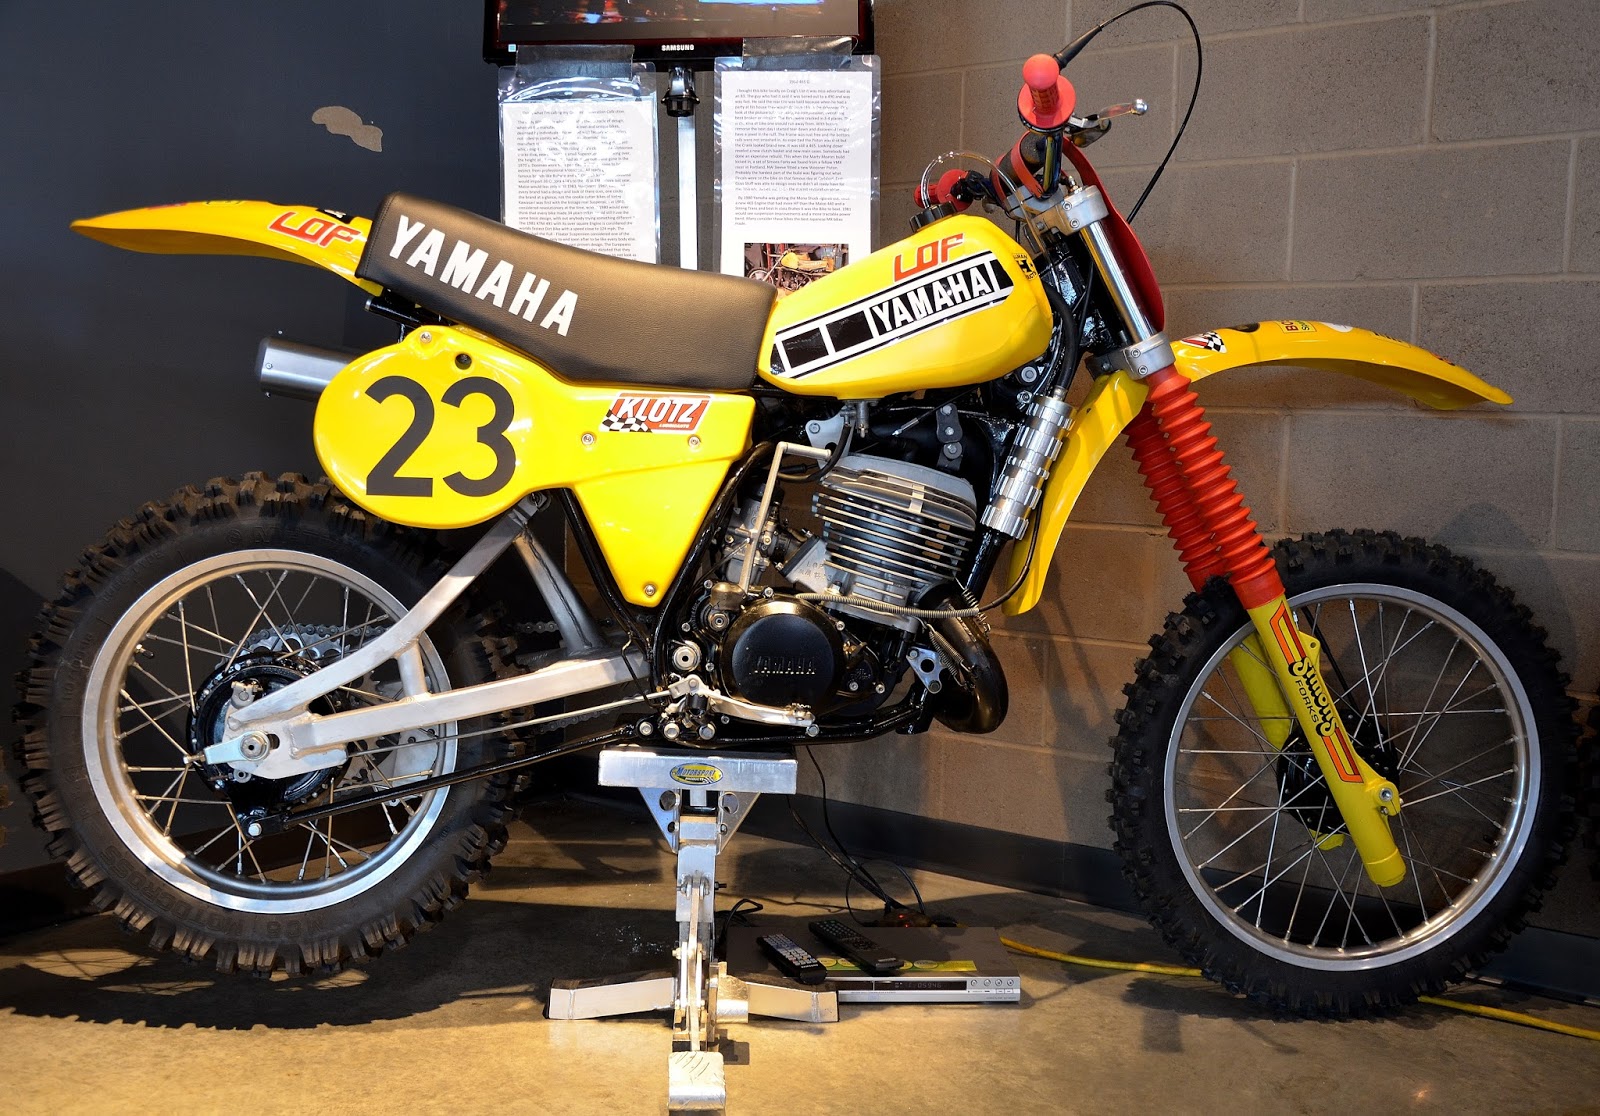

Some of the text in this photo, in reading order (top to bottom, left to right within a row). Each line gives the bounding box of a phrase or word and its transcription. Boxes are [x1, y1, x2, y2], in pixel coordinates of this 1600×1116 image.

[268, 211, 362, 248] LOF
[389, 214, 578, 337] YAMAHA
[894, 233, 964, 282] LOF
[872, 266, 991, 320] YAMAHA
[616, 396, 703, 423] KLOTZ
[364, 375, 517, 498] 23
[753, 655, 816, 675] YAMAHA
[1295, 679, 1320, 723] FORKS
